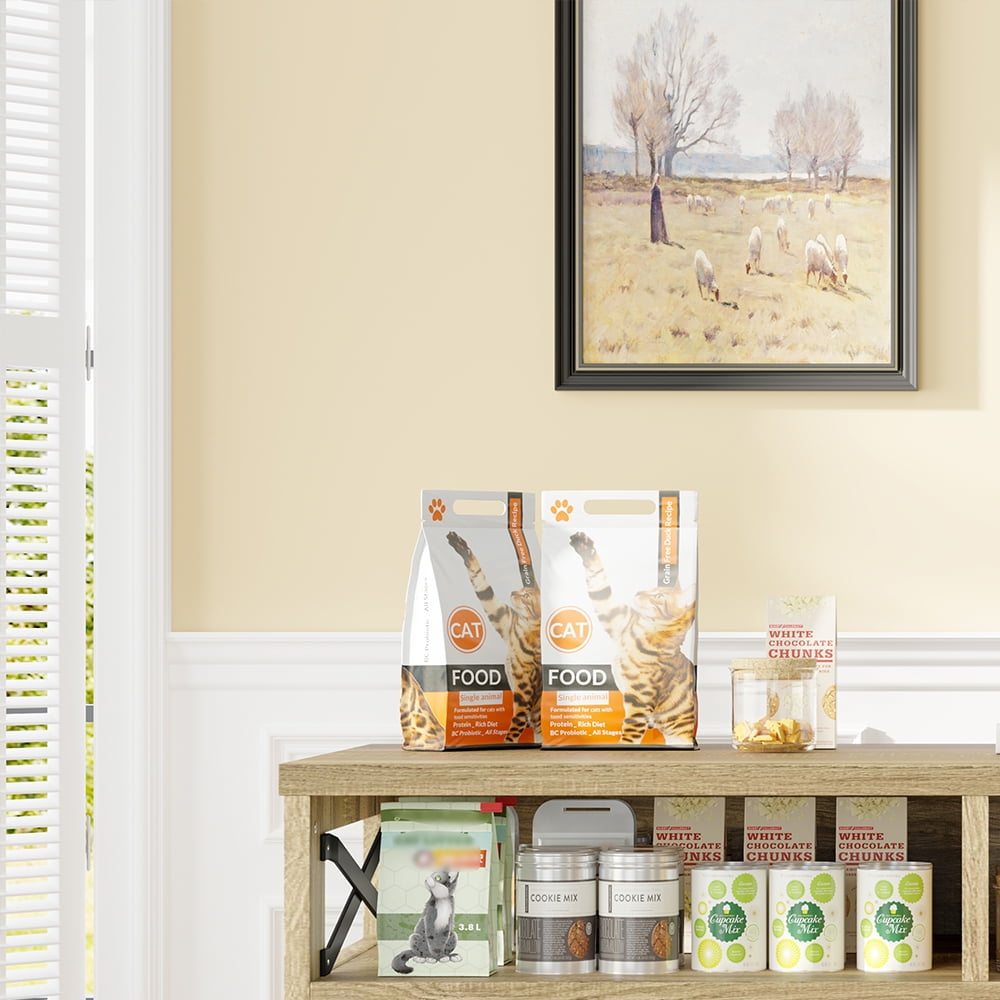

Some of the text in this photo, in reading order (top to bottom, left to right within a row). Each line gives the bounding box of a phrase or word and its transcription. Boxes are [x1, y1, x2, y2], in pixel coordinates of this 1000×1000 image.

[663, 564, 671, 584] Grain
[451, 622, 481, 638] CAT
[550, 622, 587, 638] CAT
[769, 630, 813, 638] WHITE
[768, 649, 833, 658] CHUNKS
[452, 669, 501, 686] FOOD
[548, 669, 607, 686] FOOD
[656, 832, 701, 841] WHITE
[747, 832, 792, 841] WHITE
[838, 832, 884, 841] WHITE
[746, 842, 812, 850] CHOCOLATE
[838, 842, 904, 850] CHOCOLATE
[746, 851, 812, 862] CHUNKS
[838, 851, 904, 862] CHUNKS
[530, 893, 578, 903] COOKIE MIX
[614, 893, 662, 903] COOKIE MIX
[709, 914, 744, 925] Cupcake
[787, 914, 822, 925] Cupcake
[876, 914, 910, 925] Cupcake
[458, 923, 481, 931] 3.8 L
[720, 923, 741, 935] Mix
[798, 923, 819, 934] Mix
[886, 923, 908, 934] Mix
